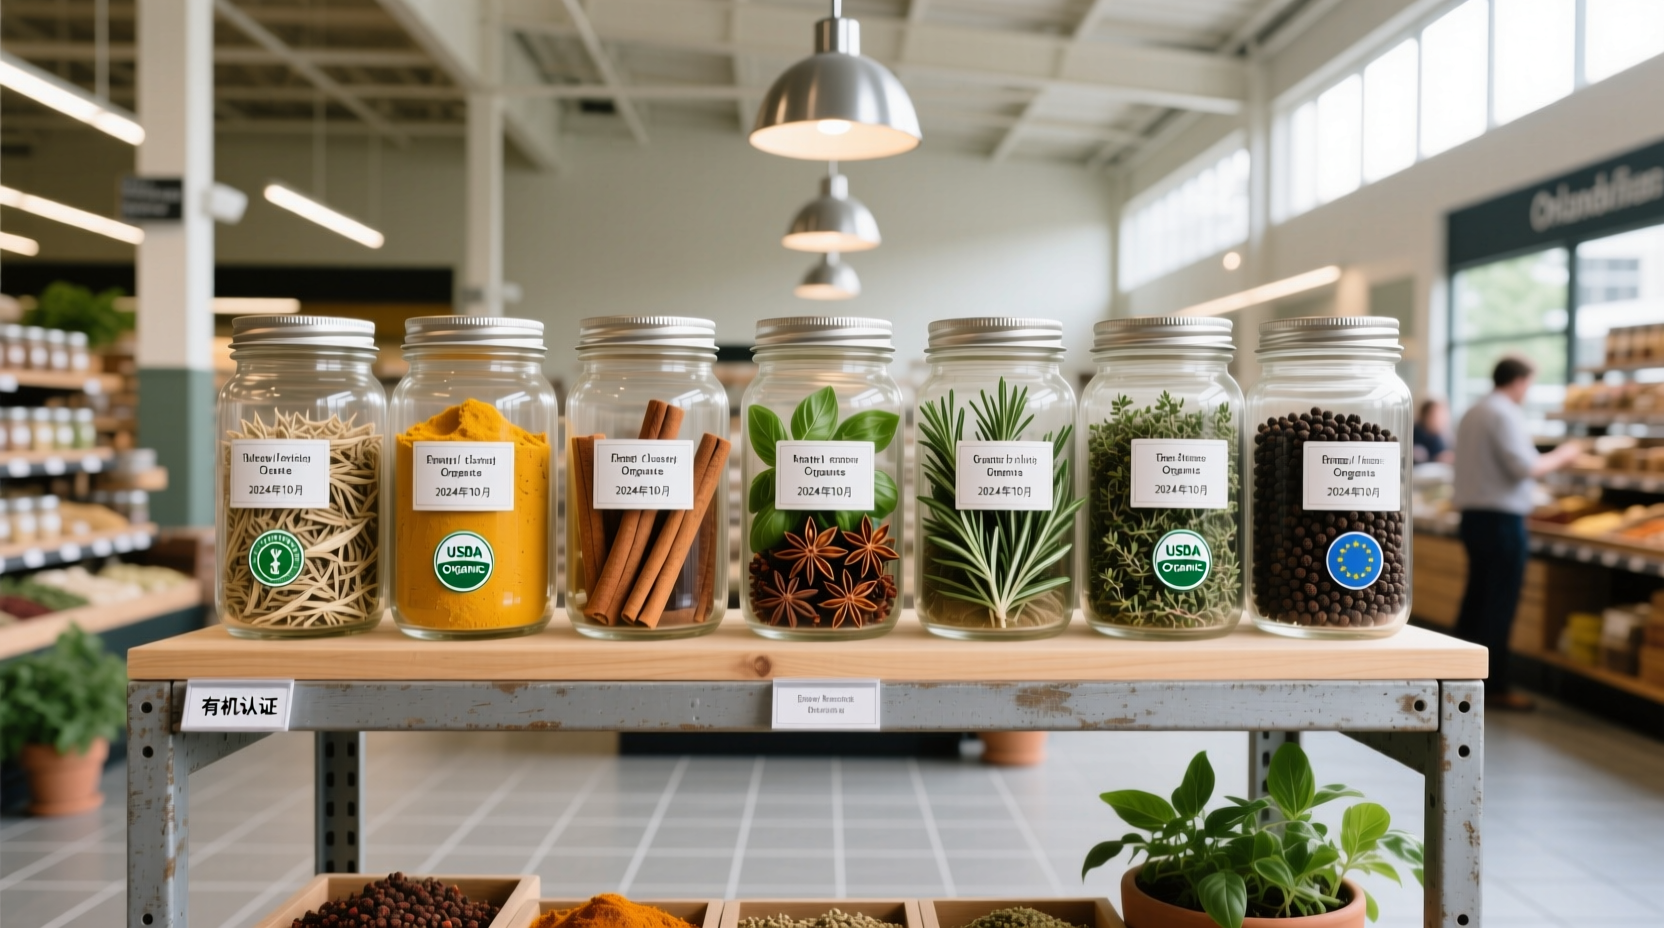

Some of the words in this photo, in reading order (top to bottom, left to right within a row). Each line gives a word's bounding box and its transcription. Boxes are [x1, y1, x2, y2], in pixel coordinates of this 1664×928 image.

[249, 485, 303, 496] 2024年10月
[435, 486, 490, 498] 2024年10月
[615, 485, 670, 497] 2024年10月
[797, 486, 852, 498] 2024年10月
[977, 485, 1031, 498] 2024年10月
[1154, 484, 1208, 496] 2024年10月
[447, 545, 483, 559] USDA
[1166, 544, 1201, 557] USDA
[201, 695, 279, 717] 有机认证
